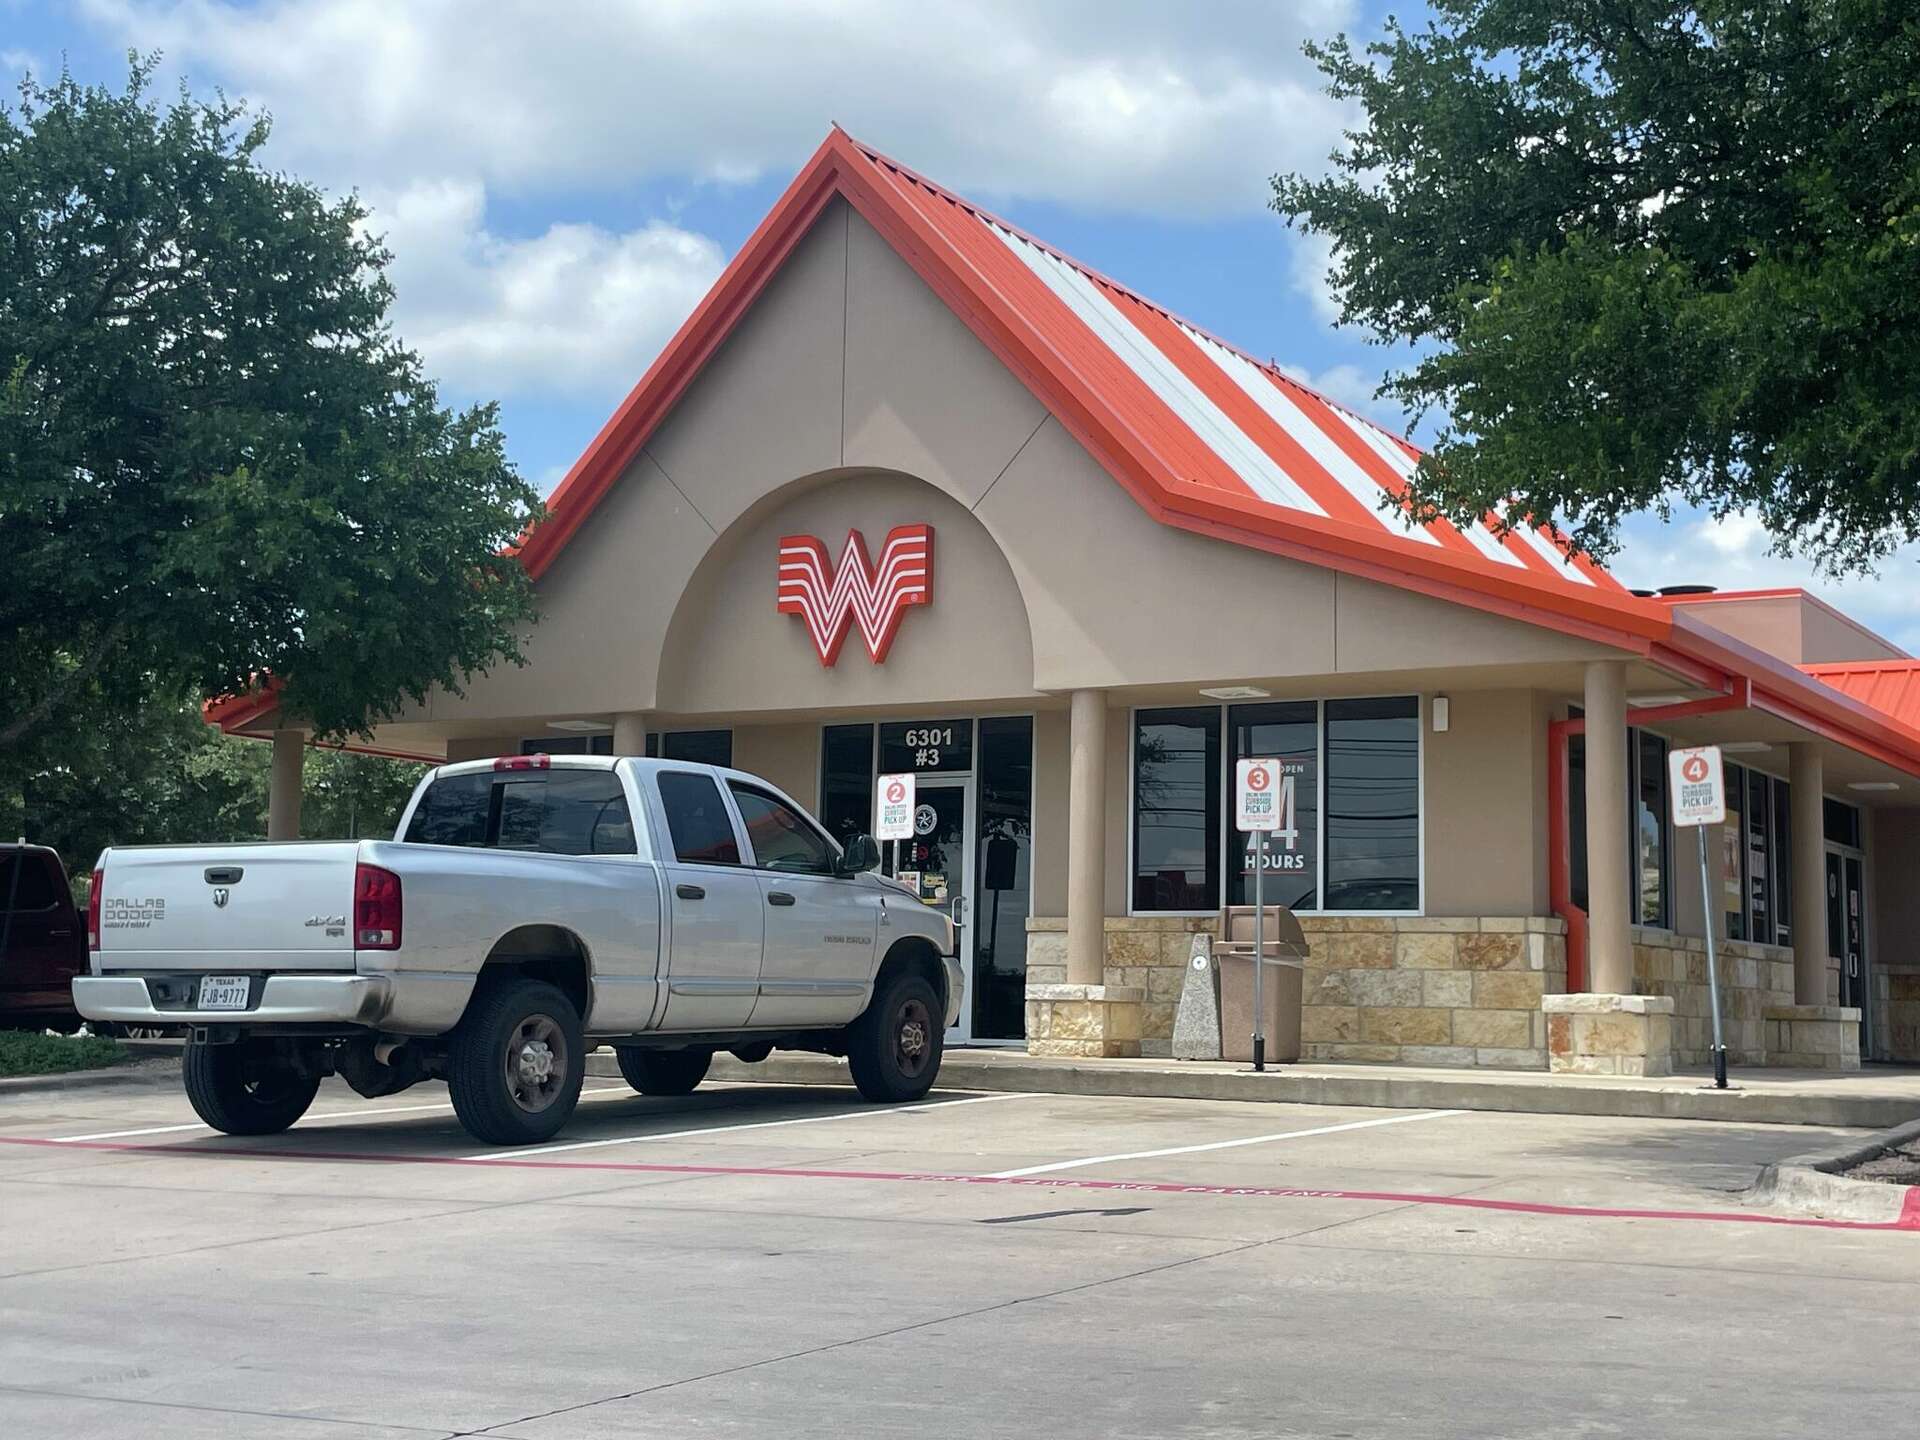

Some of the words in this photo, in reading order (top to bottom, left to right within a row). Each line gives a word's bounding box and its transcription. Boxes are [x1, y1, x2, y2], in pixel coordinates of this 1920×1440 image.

[905, 728, 952, 747] 6301
[915, 748, 940, 766] #3
[1688, 760, 1703, 778] 4
[1253, 770, 1264, 788] 3
[890, 785, 902, 802] 2
[1682, 797, 1701, 808] PICK
[1702, 796, 1713, 806] UP
[1245, 806, 1261, 814] PICK
[1262, 805, 1272, 814] UP
[884, 816, 898, 825] PICK
[898, 816, 907, 824] UP
[1244, 854, 1305, 869] HOURS
[105, 898, 165, 909] DALLAS
[105, 910, 165, 920] DODGE
[216, 978, 235, 986] TEXAS
